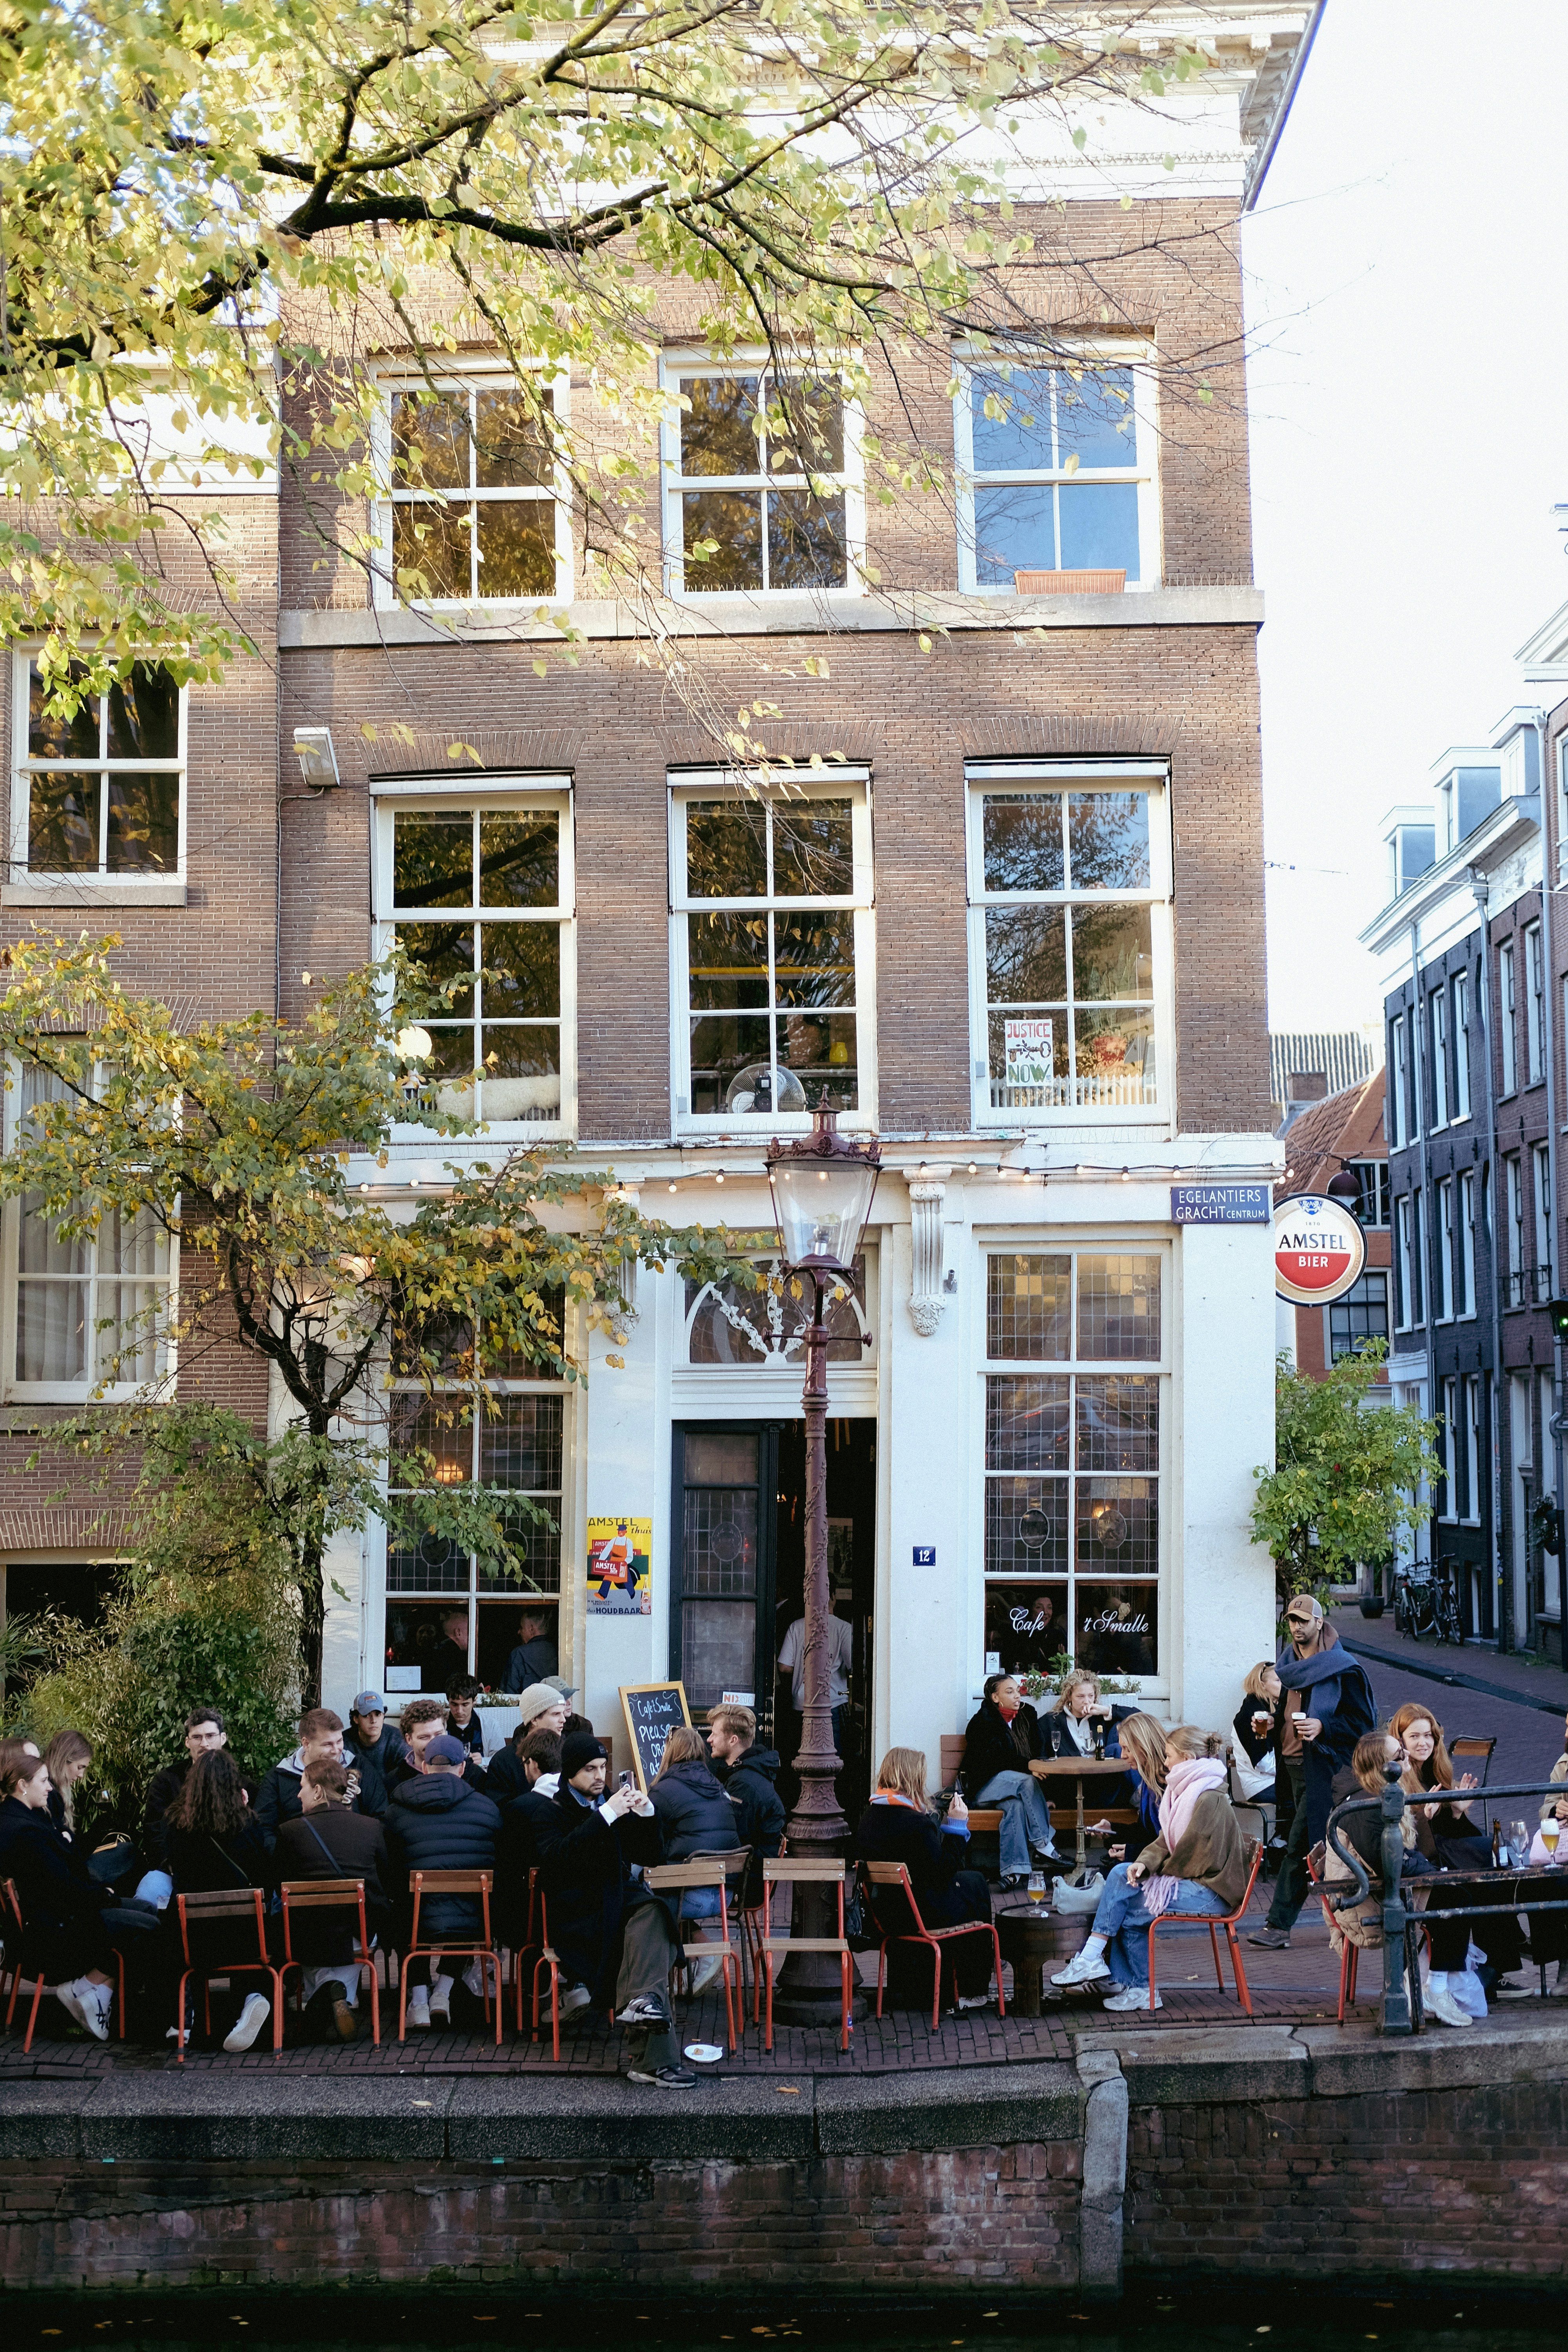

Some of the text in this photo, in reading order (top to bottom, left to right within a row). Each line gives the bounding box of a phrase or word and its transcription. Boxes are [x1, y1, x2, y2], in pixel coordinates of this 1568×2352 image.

[1007, 1022, 1050, 1038] JUSTICE
[1008, 1063, 1050, 1083] NOW
[1179, 1189, 1261, 1203] EGELANTIERS
[1176, 1206, 1226, 1219] GRACHT
[1226, 1210, 1265, 1218] CENTRUM
[1279, 1234, 1347, 1249] AMSTEL
[1299, 1256, 1328, 1267] BIER
[588, 1518, 637, 1526] AMSTEL
[631, 1526, 652, 1534] thuis
[919, 1550, 929, 1562] 12
[1010, 1608, 1045, 1637] Cafe
[1093, 1609, 1149, 1633] Smalle
[639, 1723, 670, 1742] Please
